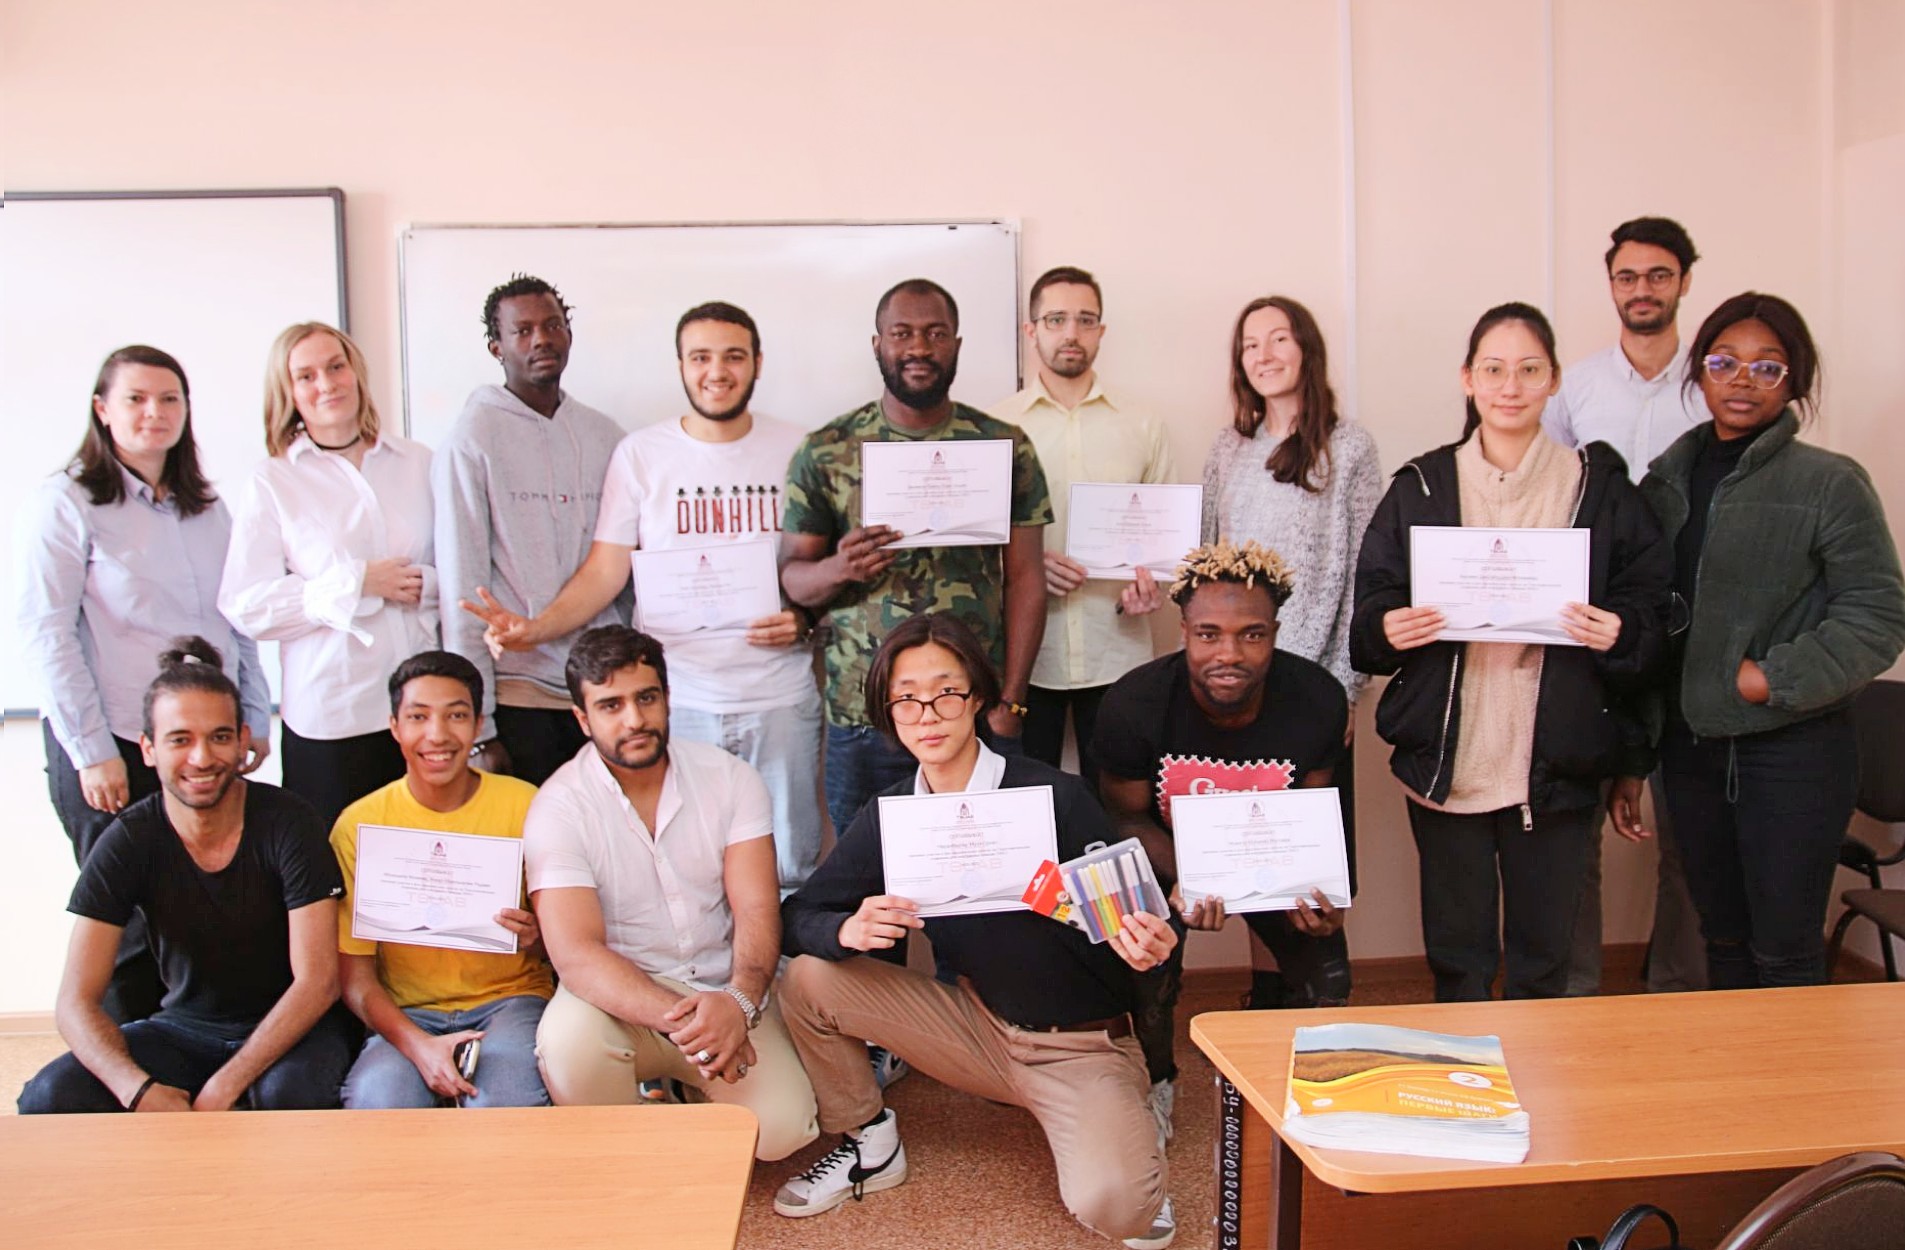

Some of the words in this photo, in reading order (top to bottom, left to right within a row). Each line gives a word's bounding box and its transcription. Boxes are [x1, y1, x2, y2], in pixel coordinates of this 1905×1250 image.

[677, 497, 783, 534] DUNHILL
[1397, 1091, 1453, 1107] РУССКИЙ
[1398, 1099, 1455, 1114] ПЕРВЫЕ
